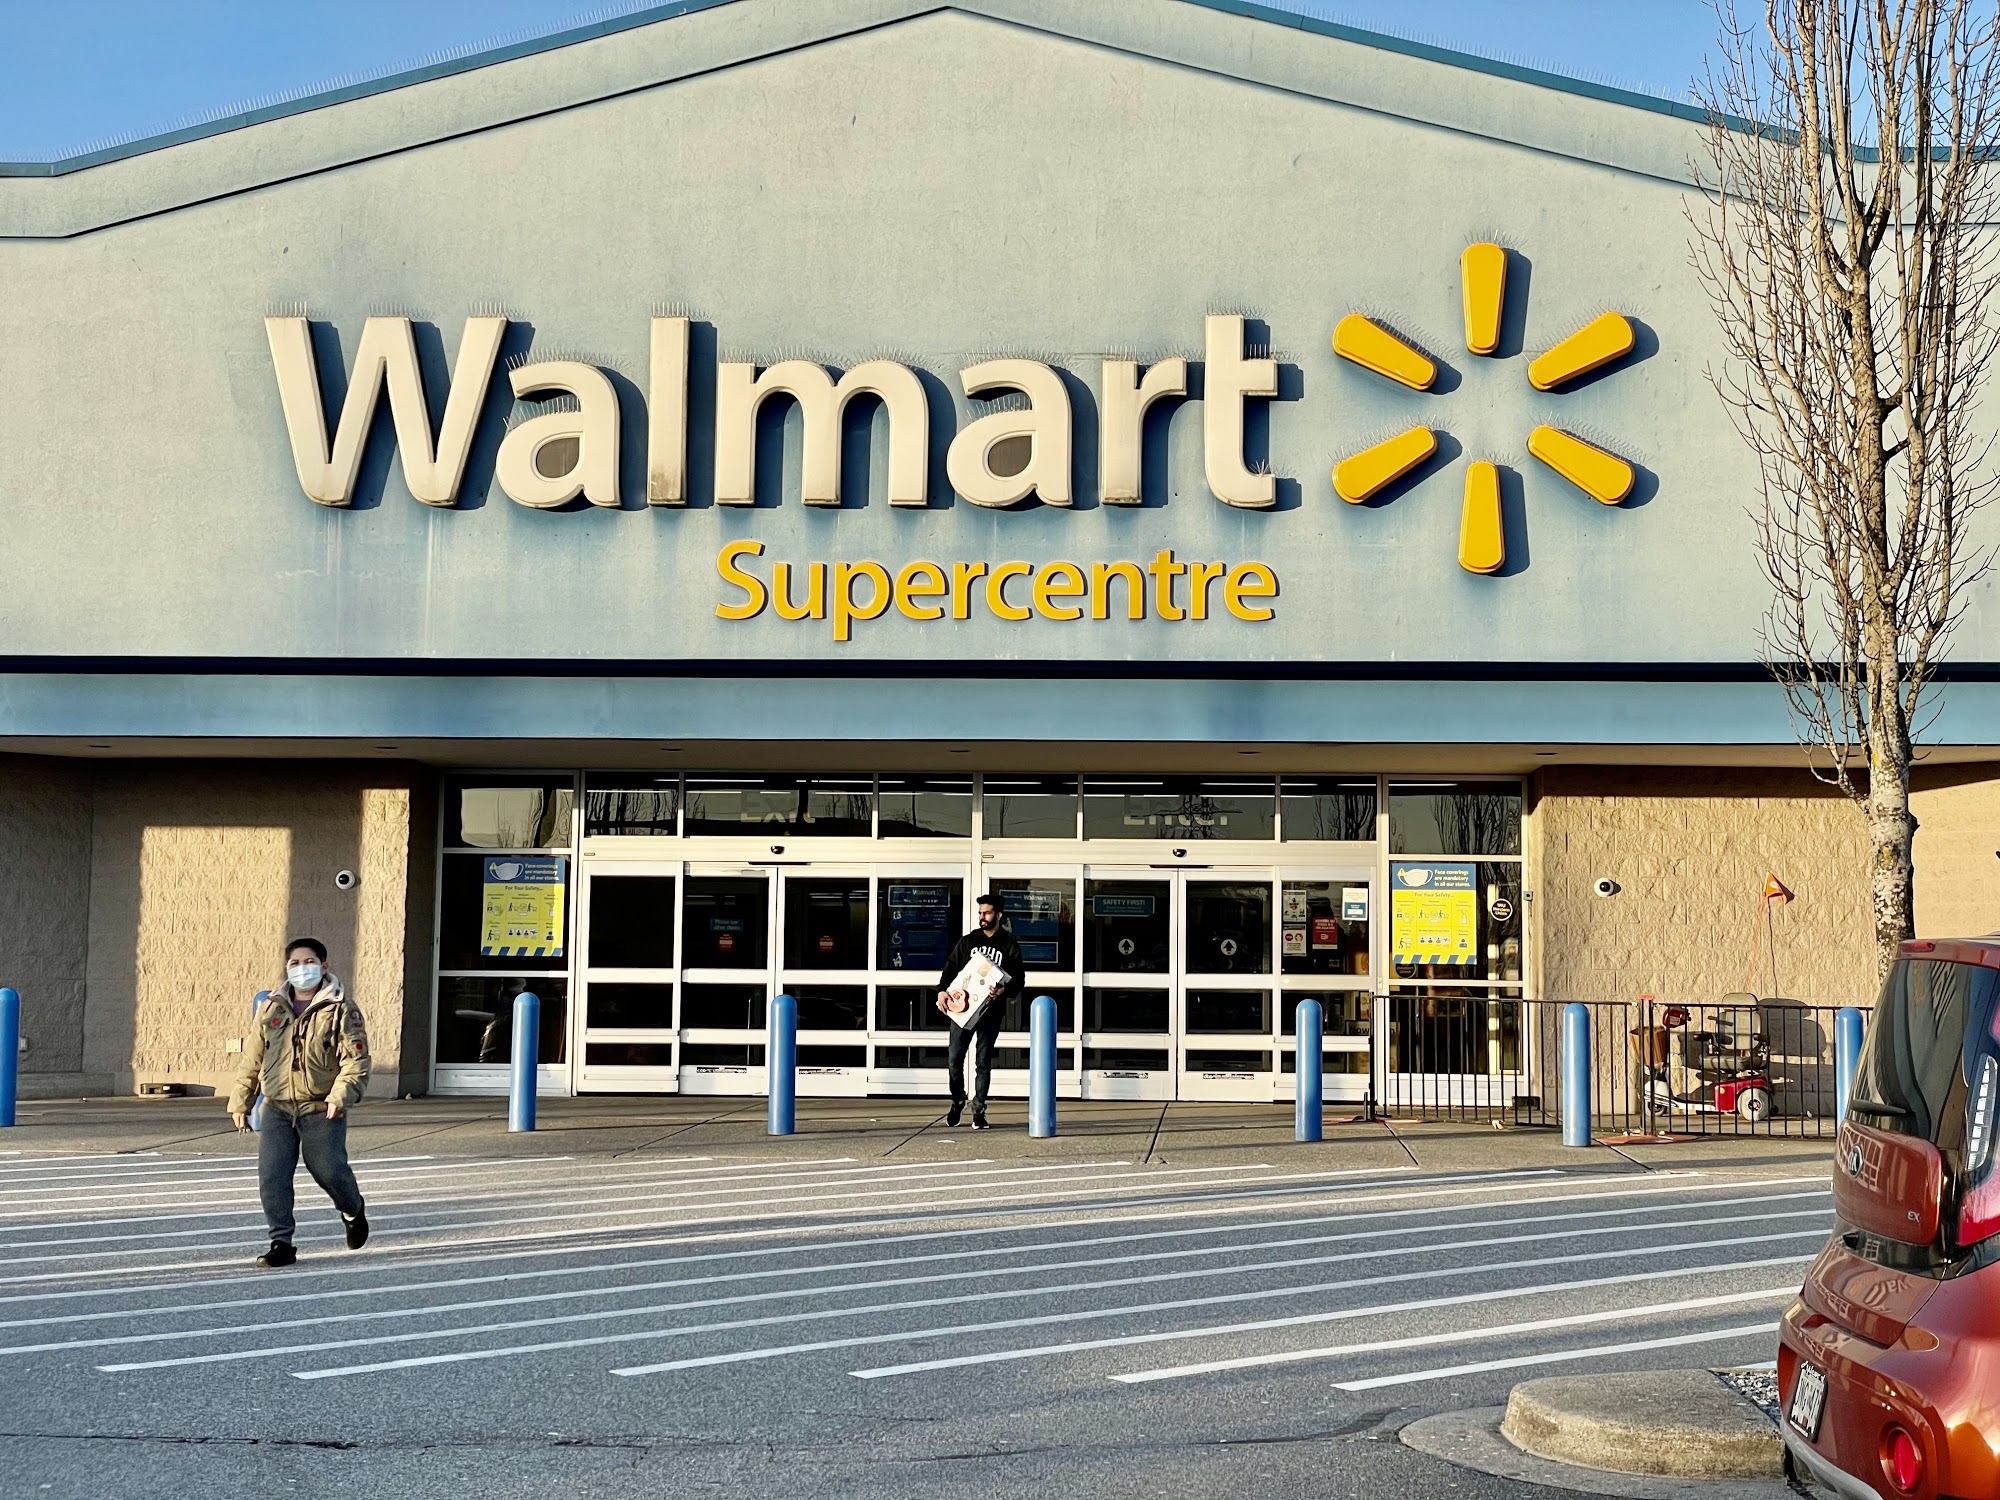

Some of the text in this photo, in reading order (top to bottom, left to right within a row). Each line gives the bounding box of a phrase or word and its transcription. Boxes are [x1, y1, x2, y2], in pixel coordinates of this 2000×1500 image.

[265, 314, 1278, 509] Walmart
[715, 539, 1278, 641] Supercentre
[1907, 1211, 1920, 1223] EX
